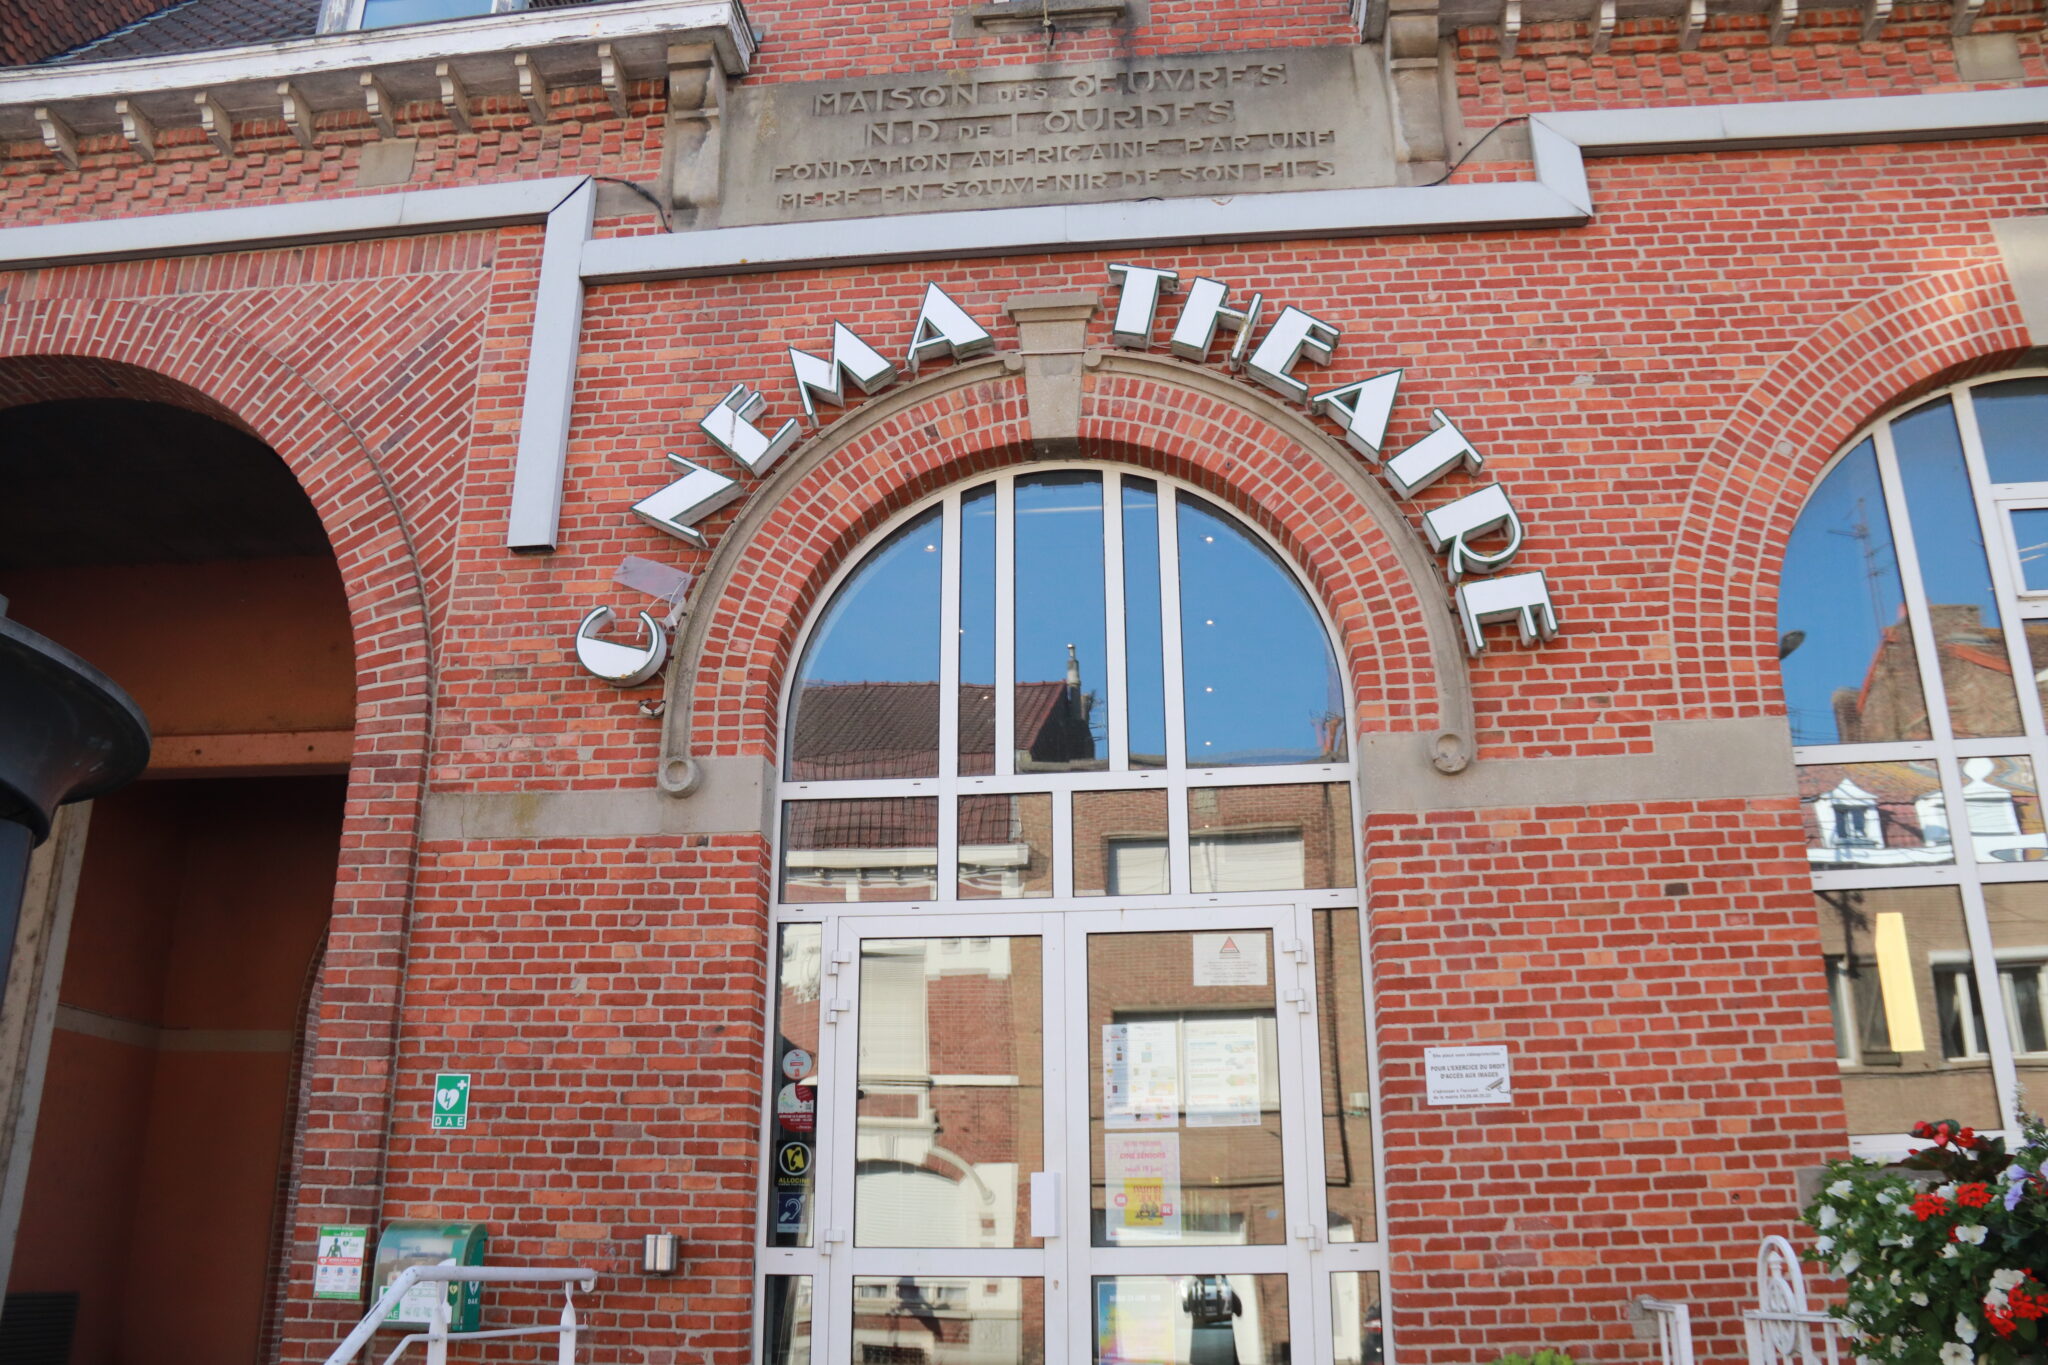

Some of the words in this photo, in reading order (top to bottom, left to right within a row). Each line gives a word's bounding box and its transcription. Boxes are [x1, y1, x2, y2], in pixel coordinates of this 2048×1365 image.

[812, 83, 979, 115] MAISON
[996, 86, 1048, 102] DES
[958, 124, 992, 141] DE
[770, 154, 951, 183] FONDATION
[969, 140, 1159, 168] AMERICAINE
[1185, 135, 1250, 153] PAR
[1268, 131, 1335, 149] UNE
[777, 191, 859, 209] MERE
[881, 184, 925, 202] EN
[941, 173, 1108, 199] SOUVENIR
[1122, 169, 1160, 187] DE
[1179, 164, 1244, 183] SON
[575, 281, 995, 687] CNEMA
[1108, 262, 1558, 658] THEATRE
[434, 1116, 465, 1127] DAE
